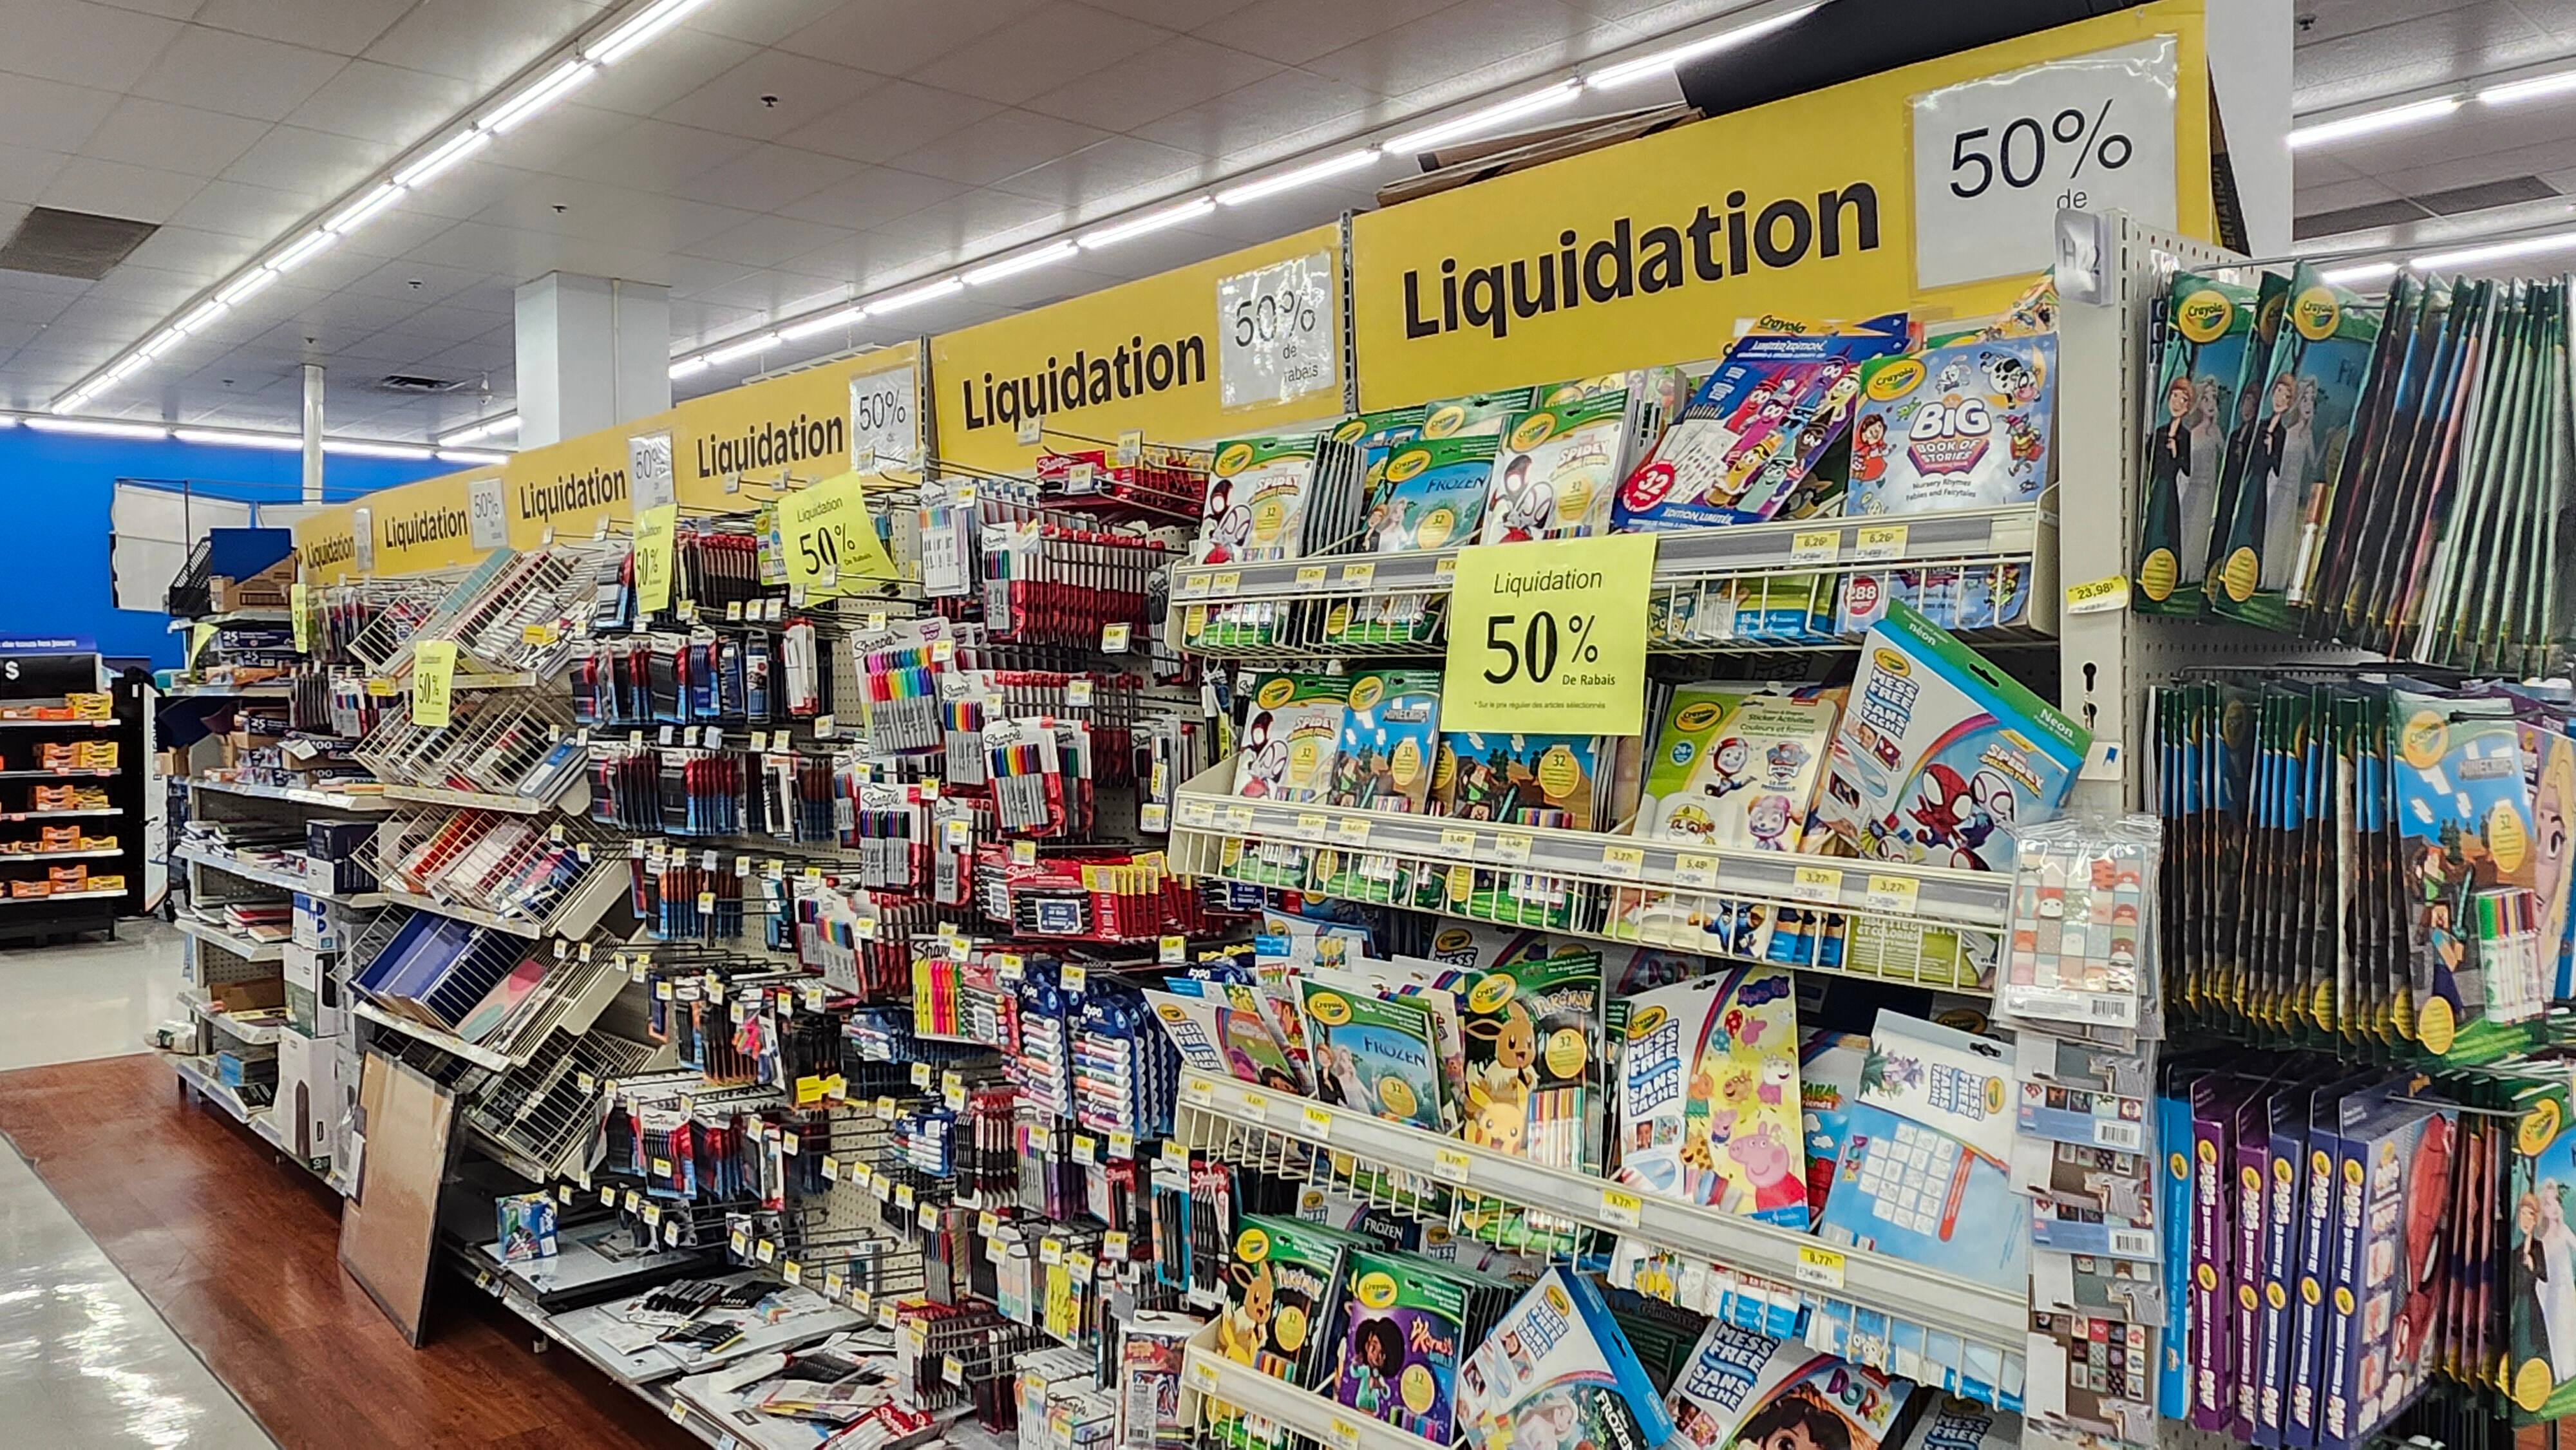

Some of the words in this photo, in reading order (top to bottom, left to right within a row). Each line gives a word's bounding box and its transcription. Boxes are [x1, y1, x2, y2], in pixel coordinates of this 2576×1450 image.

[1949, 99, 2133, 200] 50%
[2056, 187, 2087, 210] de
[1403, 181, 1880, 341] Liquidation
[1235, 290, 1316, 347] 50%
[1760, 314, 1806, 334] Crayola
[2188, 303, 2223, 318] Crayola
[1282, 343, 1297, 360] de
[963, 335, 1206, 433] Liquidation
[1283, 361, 1319, 384] rabais
[1875, 367, 1914, 386] Crayola
[859, 389, 905, 431] 50%
[697, 414, 843, 478] Liquidation
[1558, 440, 1609, 466] SPIDEY
[1916, 441, 1956, 452] BOOK
[1960, 438, 1981, 451] OF
[1920, 451, 1974, 464] STORIES
[520, 467, 627, 522] Liquidation
[1255, 473, 1302, 489] SPIDEY
[1425, 475, 1486, 494] FROZEN
[1570, 481, 1582, 493] 32
[1638, 470, 1669, 496] 32
[1913, 480, 1941, 491] Nursery
[474, 492, 499, 519] 50%
[1929, 491, 1942, 500] and
[797, 496, 843, 524] Liquidation
[1432, 514, 1445, 525] 32
[384, 506, 468, 552] Liquidation
[305, 532, 355, 572] Liquidation
[1493, 569, 1602, 598] Liquidation
[223, 631, 238, 643] 25
[1908, 622, 1937, 646] néon
[1562, 674, 1577, 686] De
[1580, 673, 1616, 686] Rabais
[1871, 670, 1919, 699] MESS
[1870, 684, 1914, 712] FREE
[251, 718, 265, 731] 25
[1294, 714, 1338, 731] SPIDEY
[1862, 711, 1905, 739] TACHE
[1866, 699, 1908, 728] SANS
[2039, 708, 2074, 739] Neon
[1402, 746, 1413, 757] 32
[1552, 754, 1566, 767] 32
[1986, 742, 2046, 791] SPIDEY
[912, 941, 951, 960] Shar
[1178, 1033, 1207, 1047] FREE
[1363, 1033, 1426, 1069] FROZEN
[1558, 1036, 1572, 1048] 32
[1628, 1026, 1679, 1057] MESS
[1629, 1044, 1678, 1075] FREE
[1629, 1071, 1680, 1102] SANS
[1630, 1086, 1679, 1116] TACHE
[1803, 1098, 1832, 1109] riends
[1363, 1216, 1404, 1239] FROZEN
[1715, 1321, 1780, 1357] MESS
[1708, 1339, 1764, 1374] FREE
[1693, 1366, 1750, 1397] SANS
[1685, 1379, 1741, 1413] TACHE
[1826, 1367, 1891, 1429] DORA
[1593, 1389, 1634, 1450] FROZE
